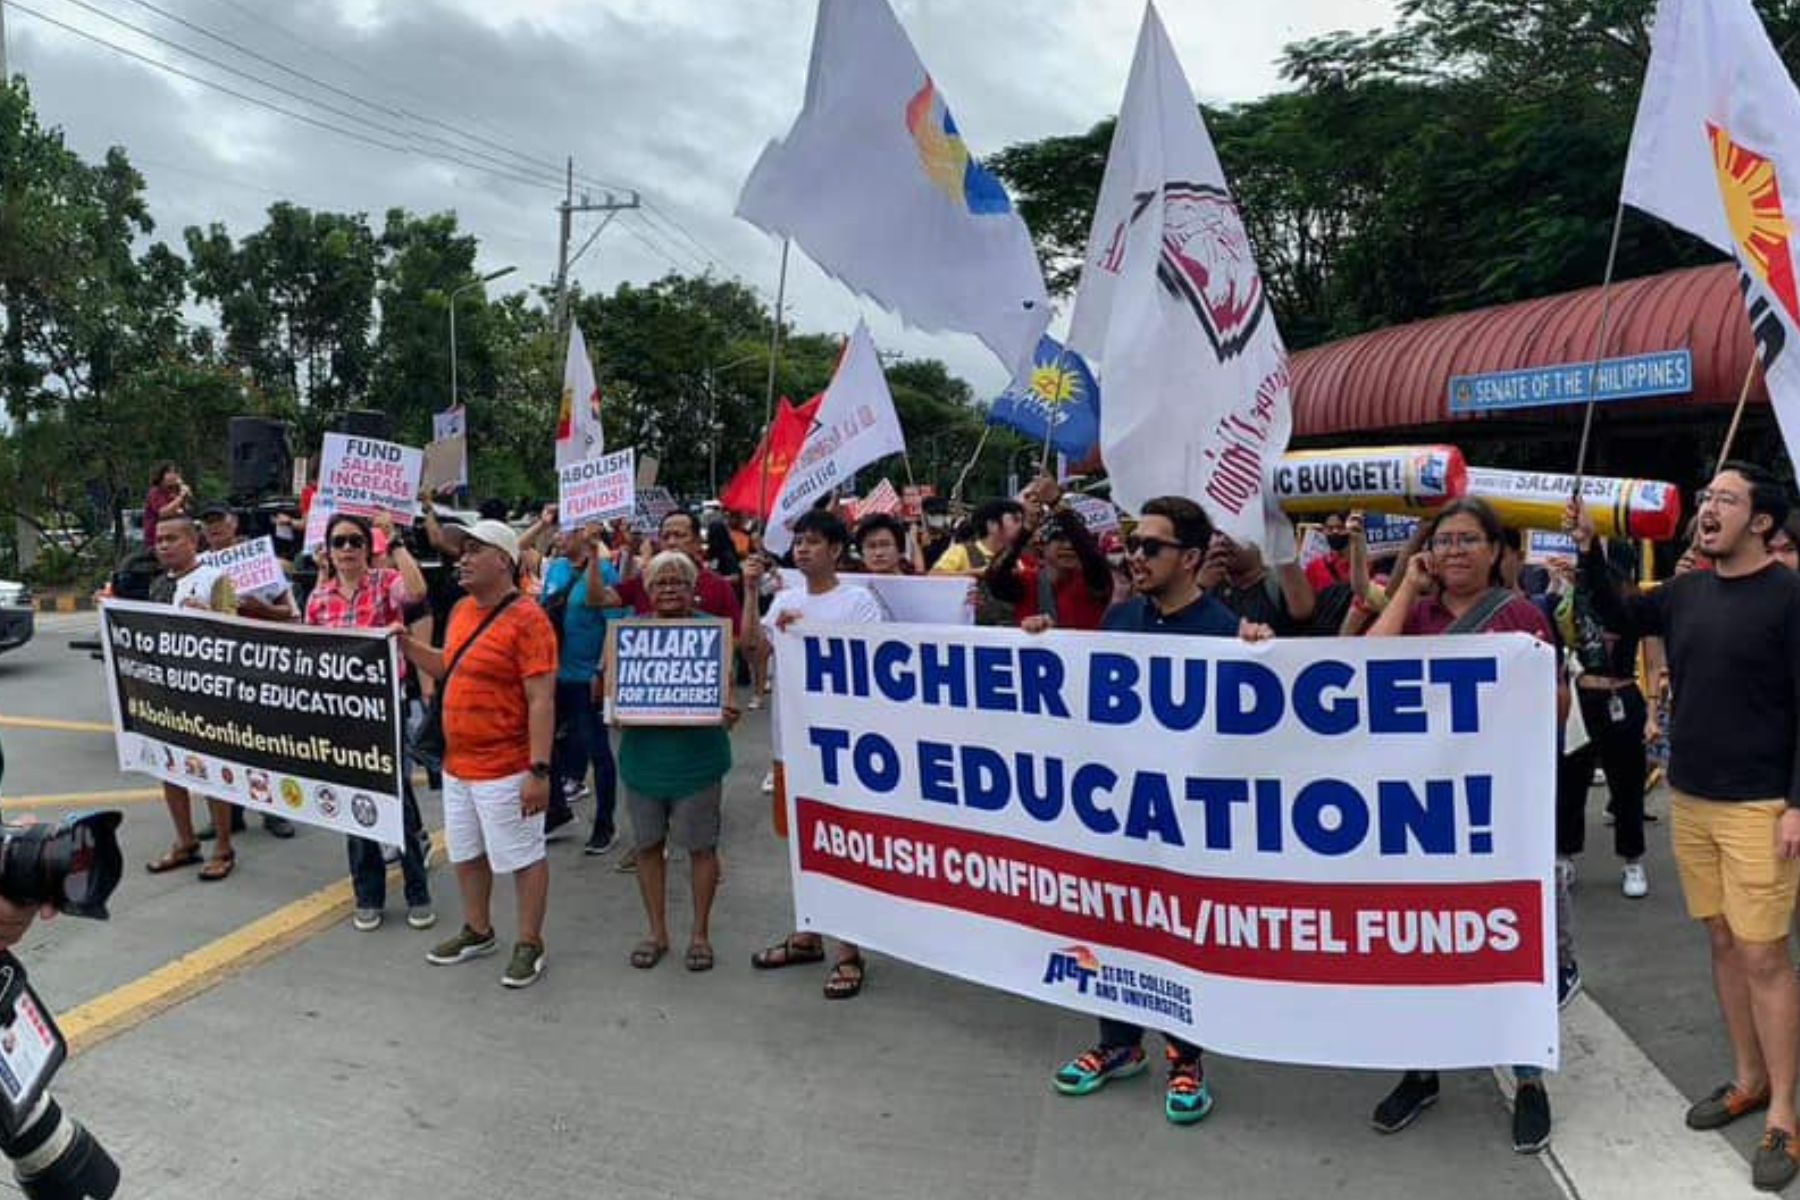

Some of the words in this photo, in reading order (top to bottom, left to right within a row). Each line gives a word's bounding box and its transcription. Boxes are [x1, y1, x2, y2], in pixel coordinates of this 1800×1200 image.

[1476, 375, 1528, 402] SENATE
[1532, 374, 1550, 398] OF
[1555, 370, 1583, 394] THE
[346, 439, 402, 463] FUND
[562, 451, 630, 482] ABOLISH
[341, 457, 404, 478] SALARY
[1300, 460, 1400, 494] BUDGET!
[330, 470, 409, 497] INCREASE
[1515, 475, 1613, 496] SALAES!
[567, 486, 625, 514] FUNDS!
[201, 541, 267, 568] HIGHER
[135, 631, 155, 652] to
[159, 631, 237, 663] BUDGET
[240, 641, 291, 672] CUTS
[294, 648, 313, 677] in
[318, 652, 386, 685] SUCs!
[618, 628, 718, 658] SALARY
[619, 659, 718, 685] INCREASE
[804, 636, 1070, 719] HIGHER
[1088, 651, 1497, 736] BUDGET
[166, 667, 235, 698] BUDGET
[238, 681, 256, 703] to
[259, 681, 387, 722] EDUCATION!
[619, 686, 645, 703] FOR
[648, 686, 718, 703] TEACHERS!
[127, 697, 393, 774] #AbolishConfidentialFunds
[808, 726, 901, 792] TO
[916, 740, 1493, 856] EDUCATION!
[813, 819, 936, 878] ABOLISH
[943, 847, 1346, 953] CONFIDENTIAL/INTEL
[1357, 907, 1520, 954] FUNDS
[1101, 964, 1137, 987] STATE
[1138, 970, 1192, 1005] COLLEGES
[1095, 981, 1118, 1002] AND
[1121, 986, 1194, 1026] UNIVERSITIES
